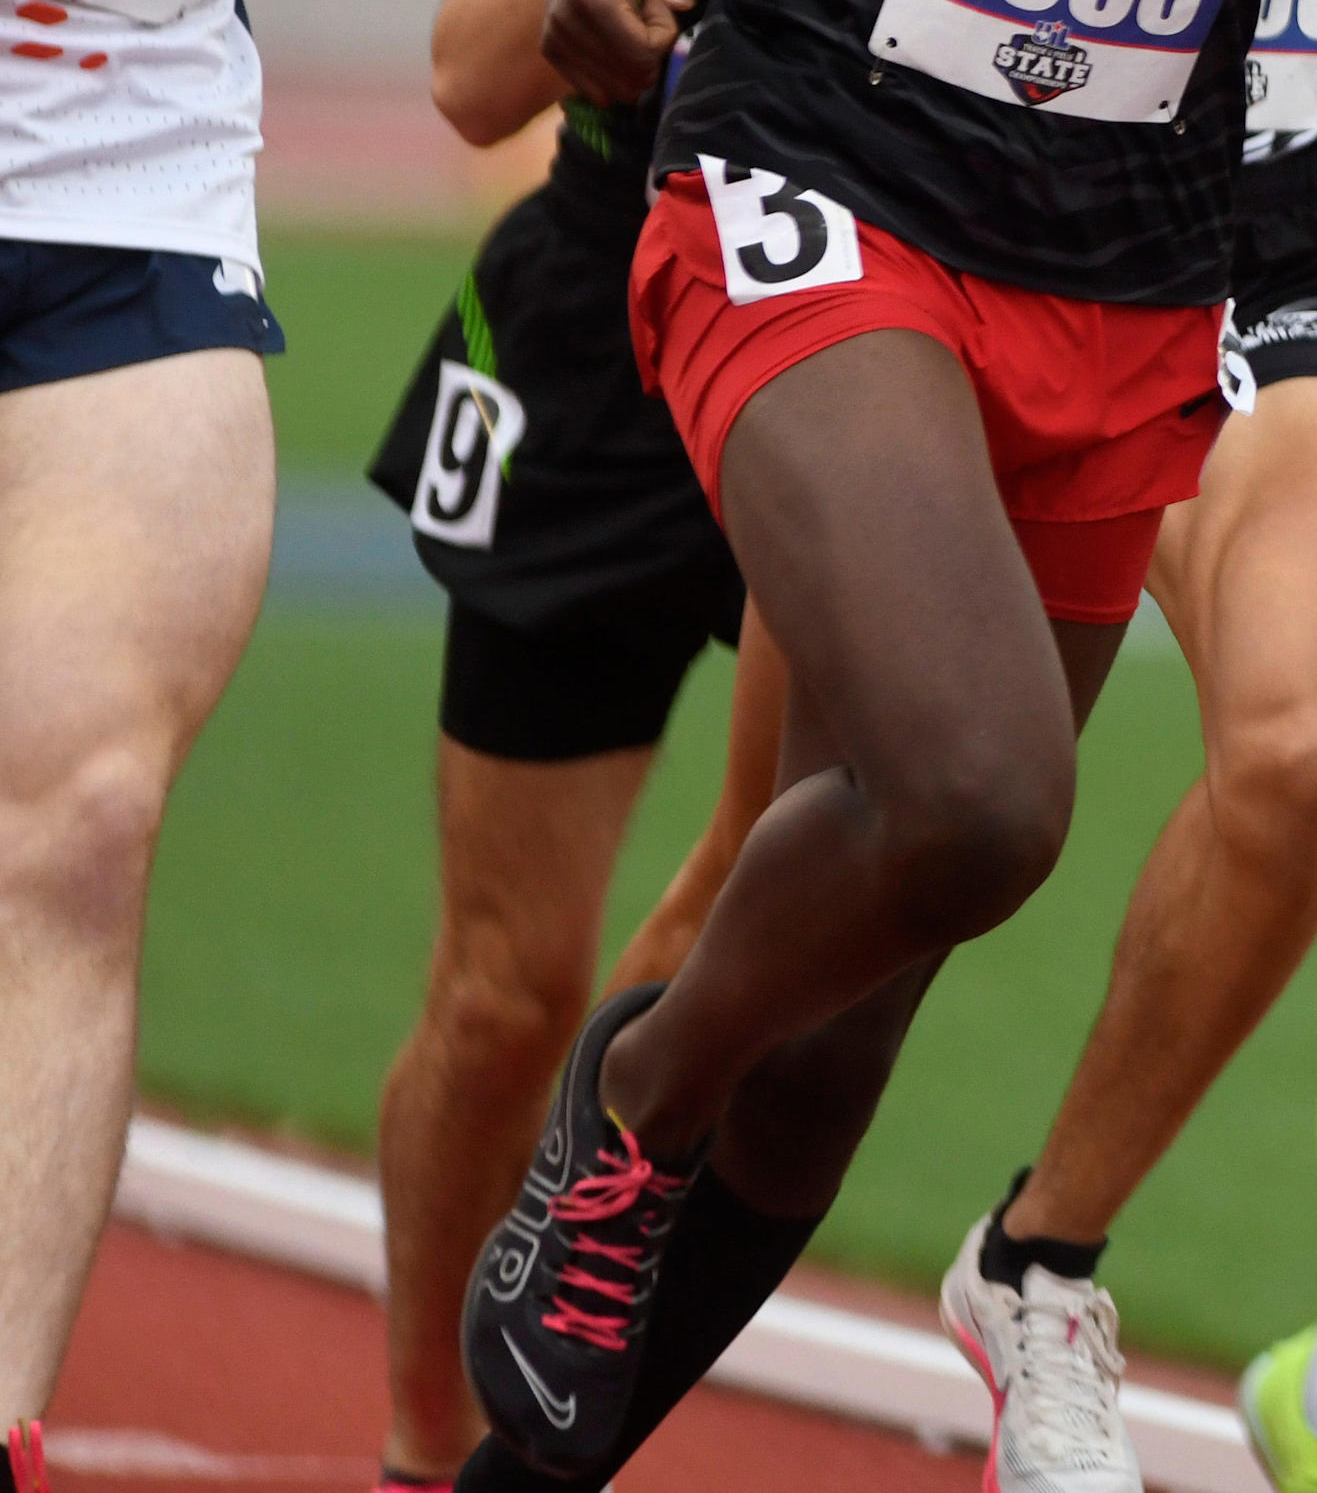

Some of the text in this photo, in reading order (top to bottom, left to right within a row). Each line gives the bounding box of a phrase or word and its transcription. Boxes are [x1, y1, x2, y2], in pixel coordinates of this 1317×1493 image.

[995, 45, 1091, 85] STATE
[724, 158, 828, 284] 3
[425, 386, 501, 521] 9
